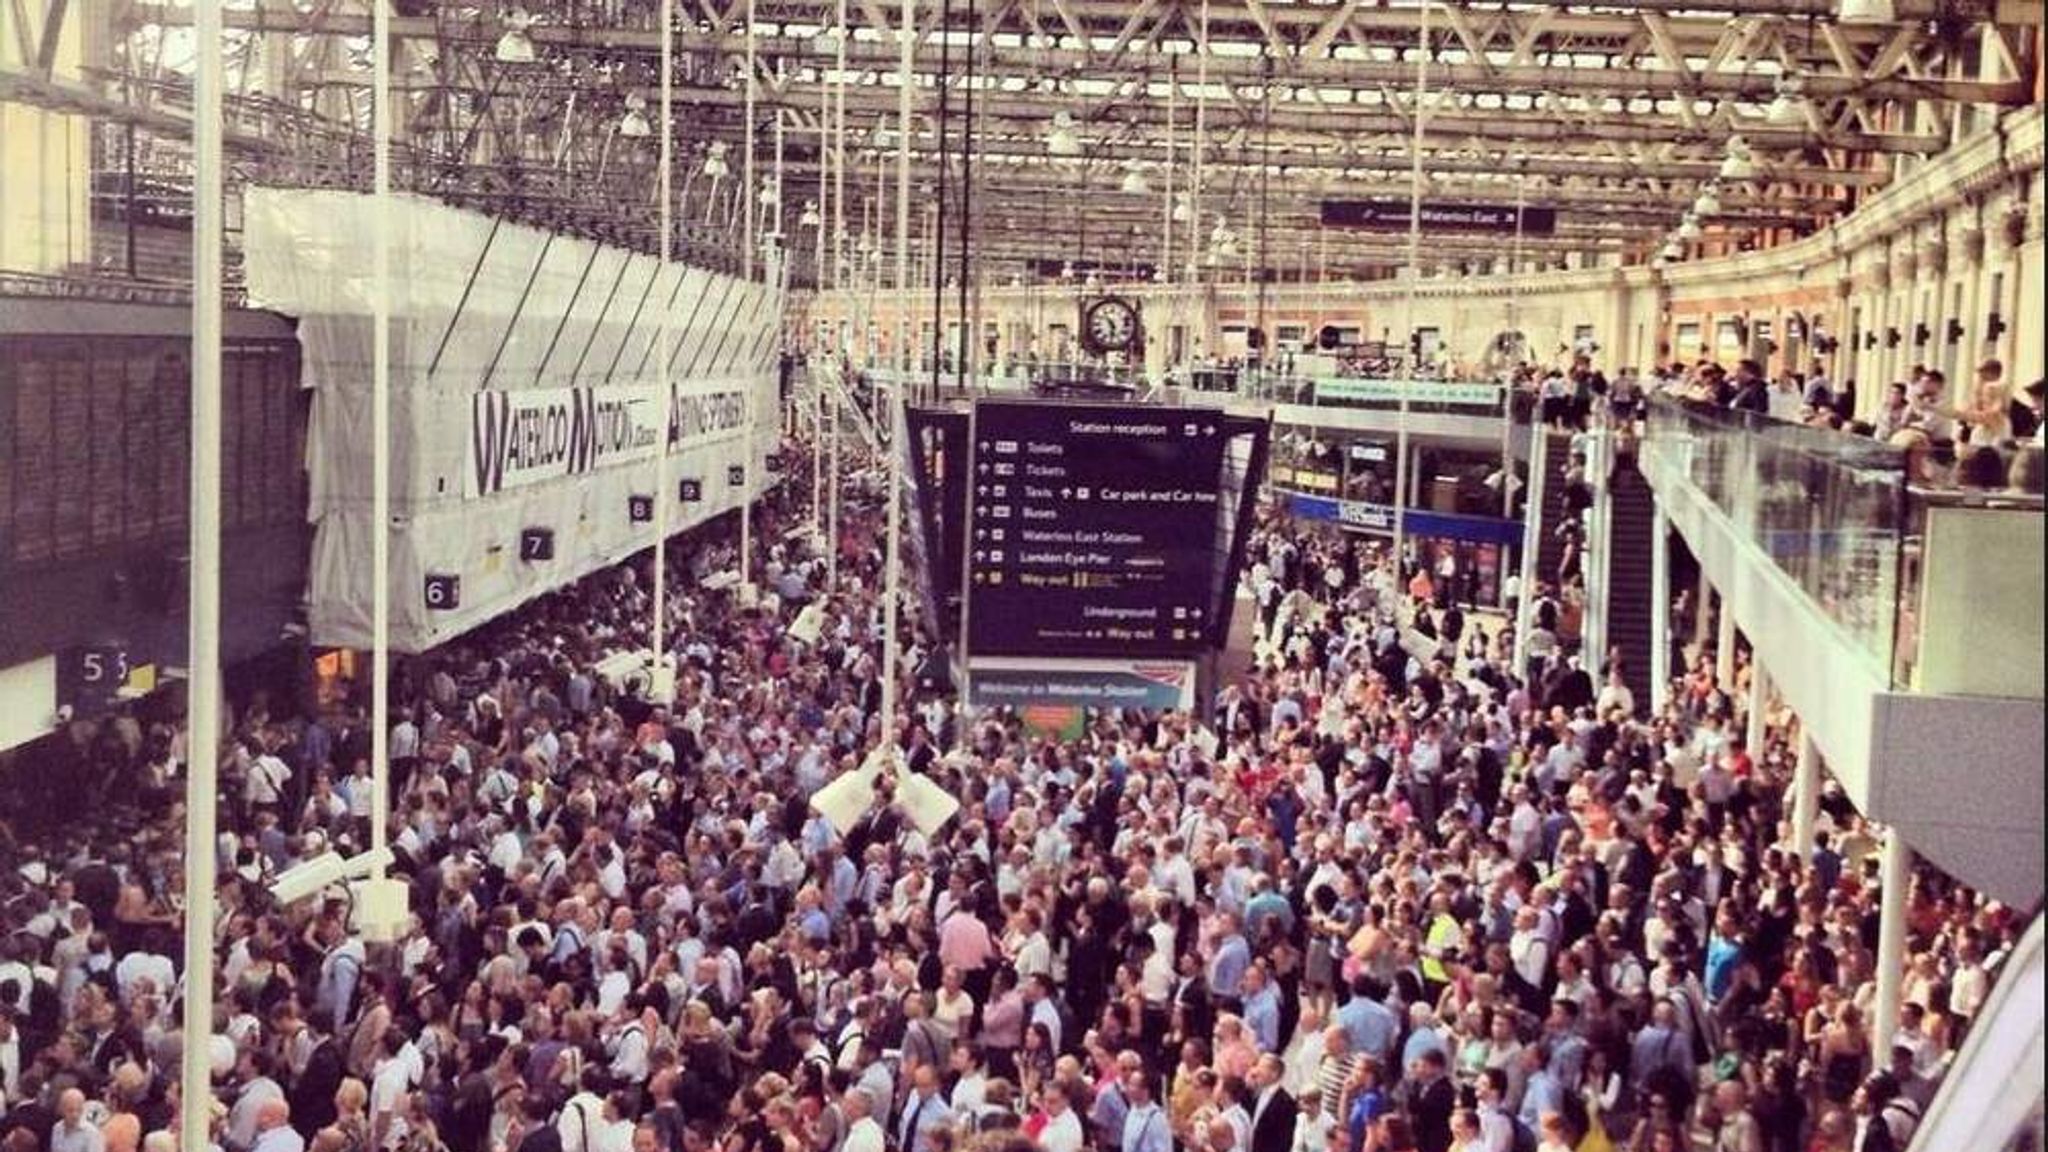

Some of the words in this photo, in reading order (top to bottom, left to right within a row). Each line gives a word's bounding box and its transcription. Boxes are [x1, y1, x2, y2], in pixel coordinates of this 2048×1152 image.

[1421, 210, 1471, 222] Waterloo
[1474, 211, 1498, 223] East
[1069, 420, 1112, 434] Station
[1113, 423, 1167, 436] reception
[473, 391, 568, 497] WATERLOO
[567, 387, 633, 475] MOTION
[1026, 441, 1063, 455] Toilets
[1025, 464, 1066, 477] Tickets
[1025, 486, 1053, 497] Taxis
[1101, 488, 1120, 500] Car
[1122, 489, 1147, 502] park
[1150, 490, 1171, 501] and
[1173, 490, 1192, 501] Car
[633, 499, 645, 517] 8
[1022, 507, 1057, 519] Buses
[1022, 530, 1072, 542] Waterloo
[1074, 531, 1099, 542] East
[1101, 531, 1143, 543] Station
[528, 536, 542, 554] 7
[1019, 552, 1062, 564] London
[1064, 552, 1085, 566] Eye
[1087, 552, 1112, 564] Pier
[1020, 573, 1045, 586] Way
[1049, 574, 1069, 585] out
[427, 581, 443, 602] 6
[1083, 606, 1157, 619] Underground
[1107, 628, 1132, 640] Way
[1134, 628, 1154, 639] out
[83, 653, 103, 681] 5
